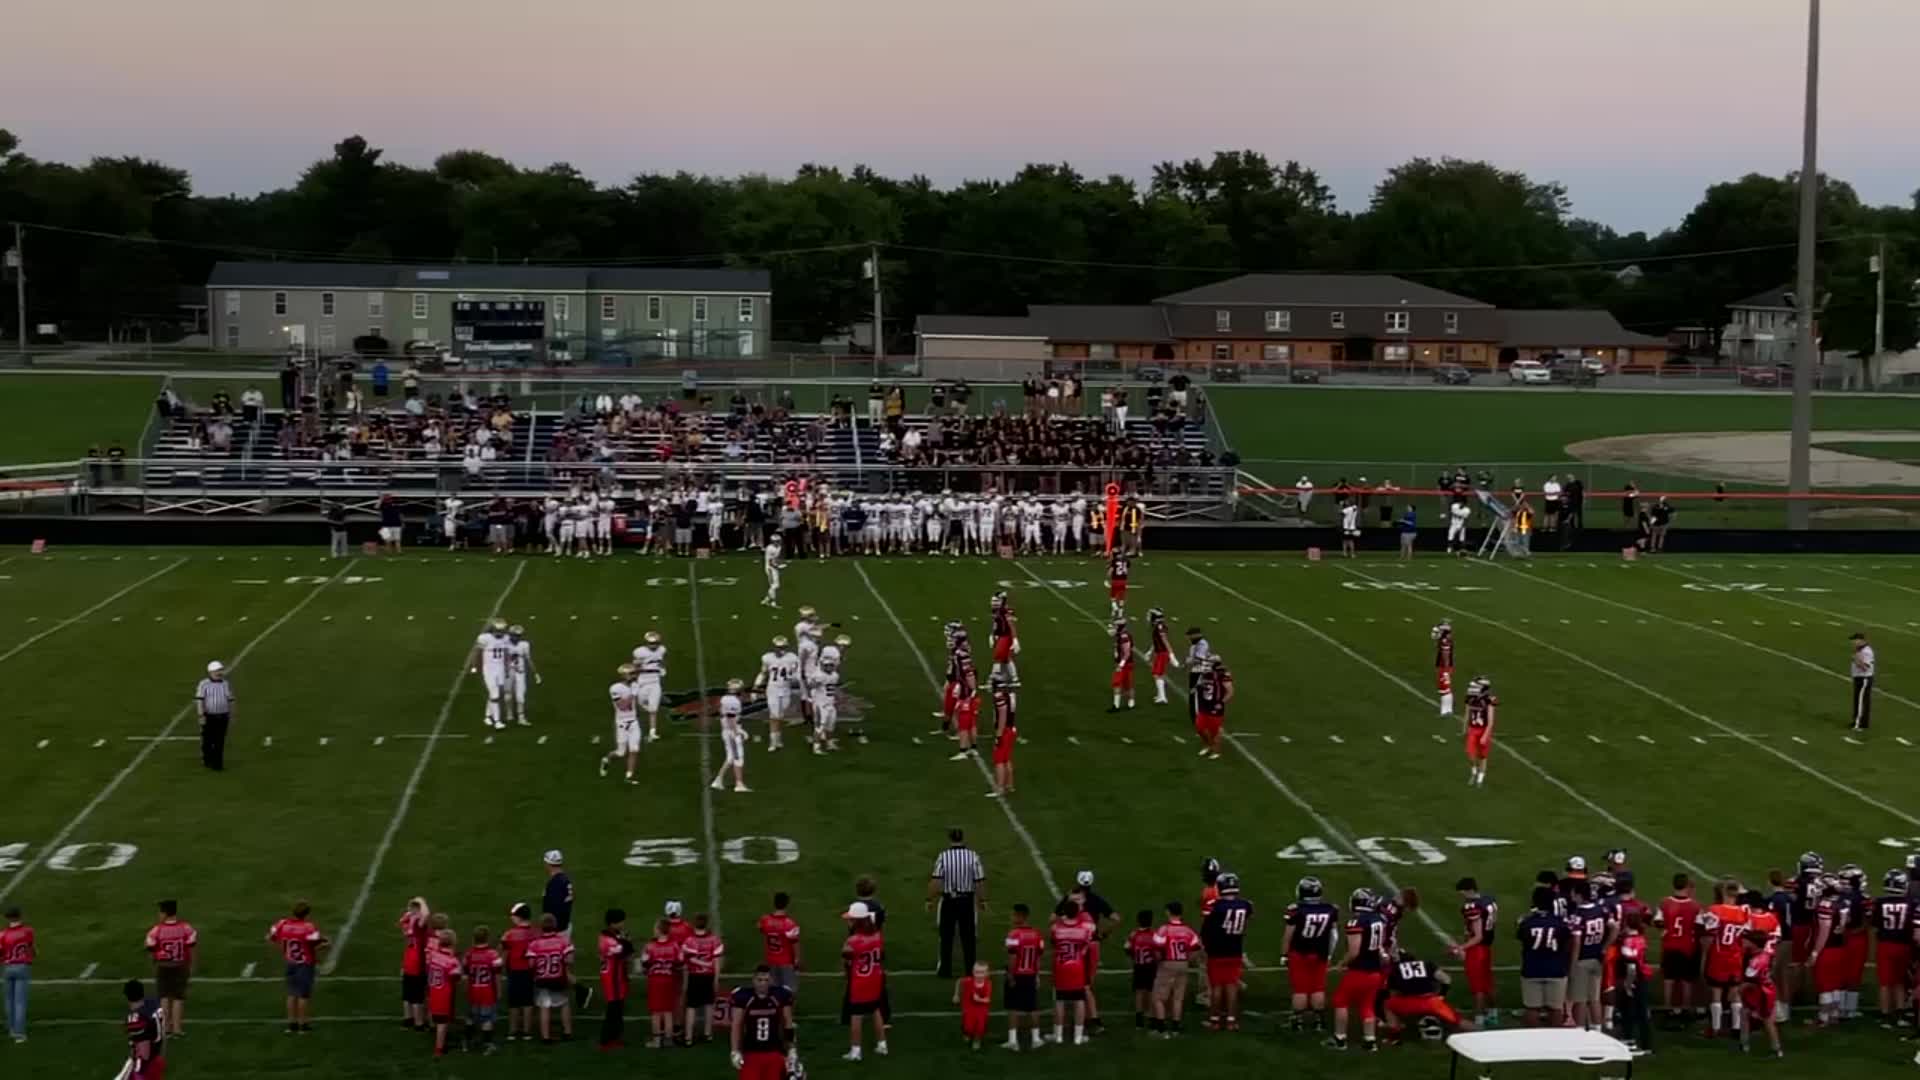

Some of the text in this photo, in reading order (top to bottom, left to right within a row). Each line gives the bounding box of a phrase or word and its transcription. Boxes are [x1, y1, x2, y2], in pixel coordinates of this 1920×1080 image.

[624, 837, 798, 866] 50
[1275, 838, 1446, 865] 40
[1220, 908, 1247, 935] 40
[1301, 913, 1329, 939] 67
[1879, 903, 1907, 930] 57
[1530, 927, 1558, 952] 74
[1399, 960, 1427, 980] 83
[756, 1017, 770, 1042] 8
